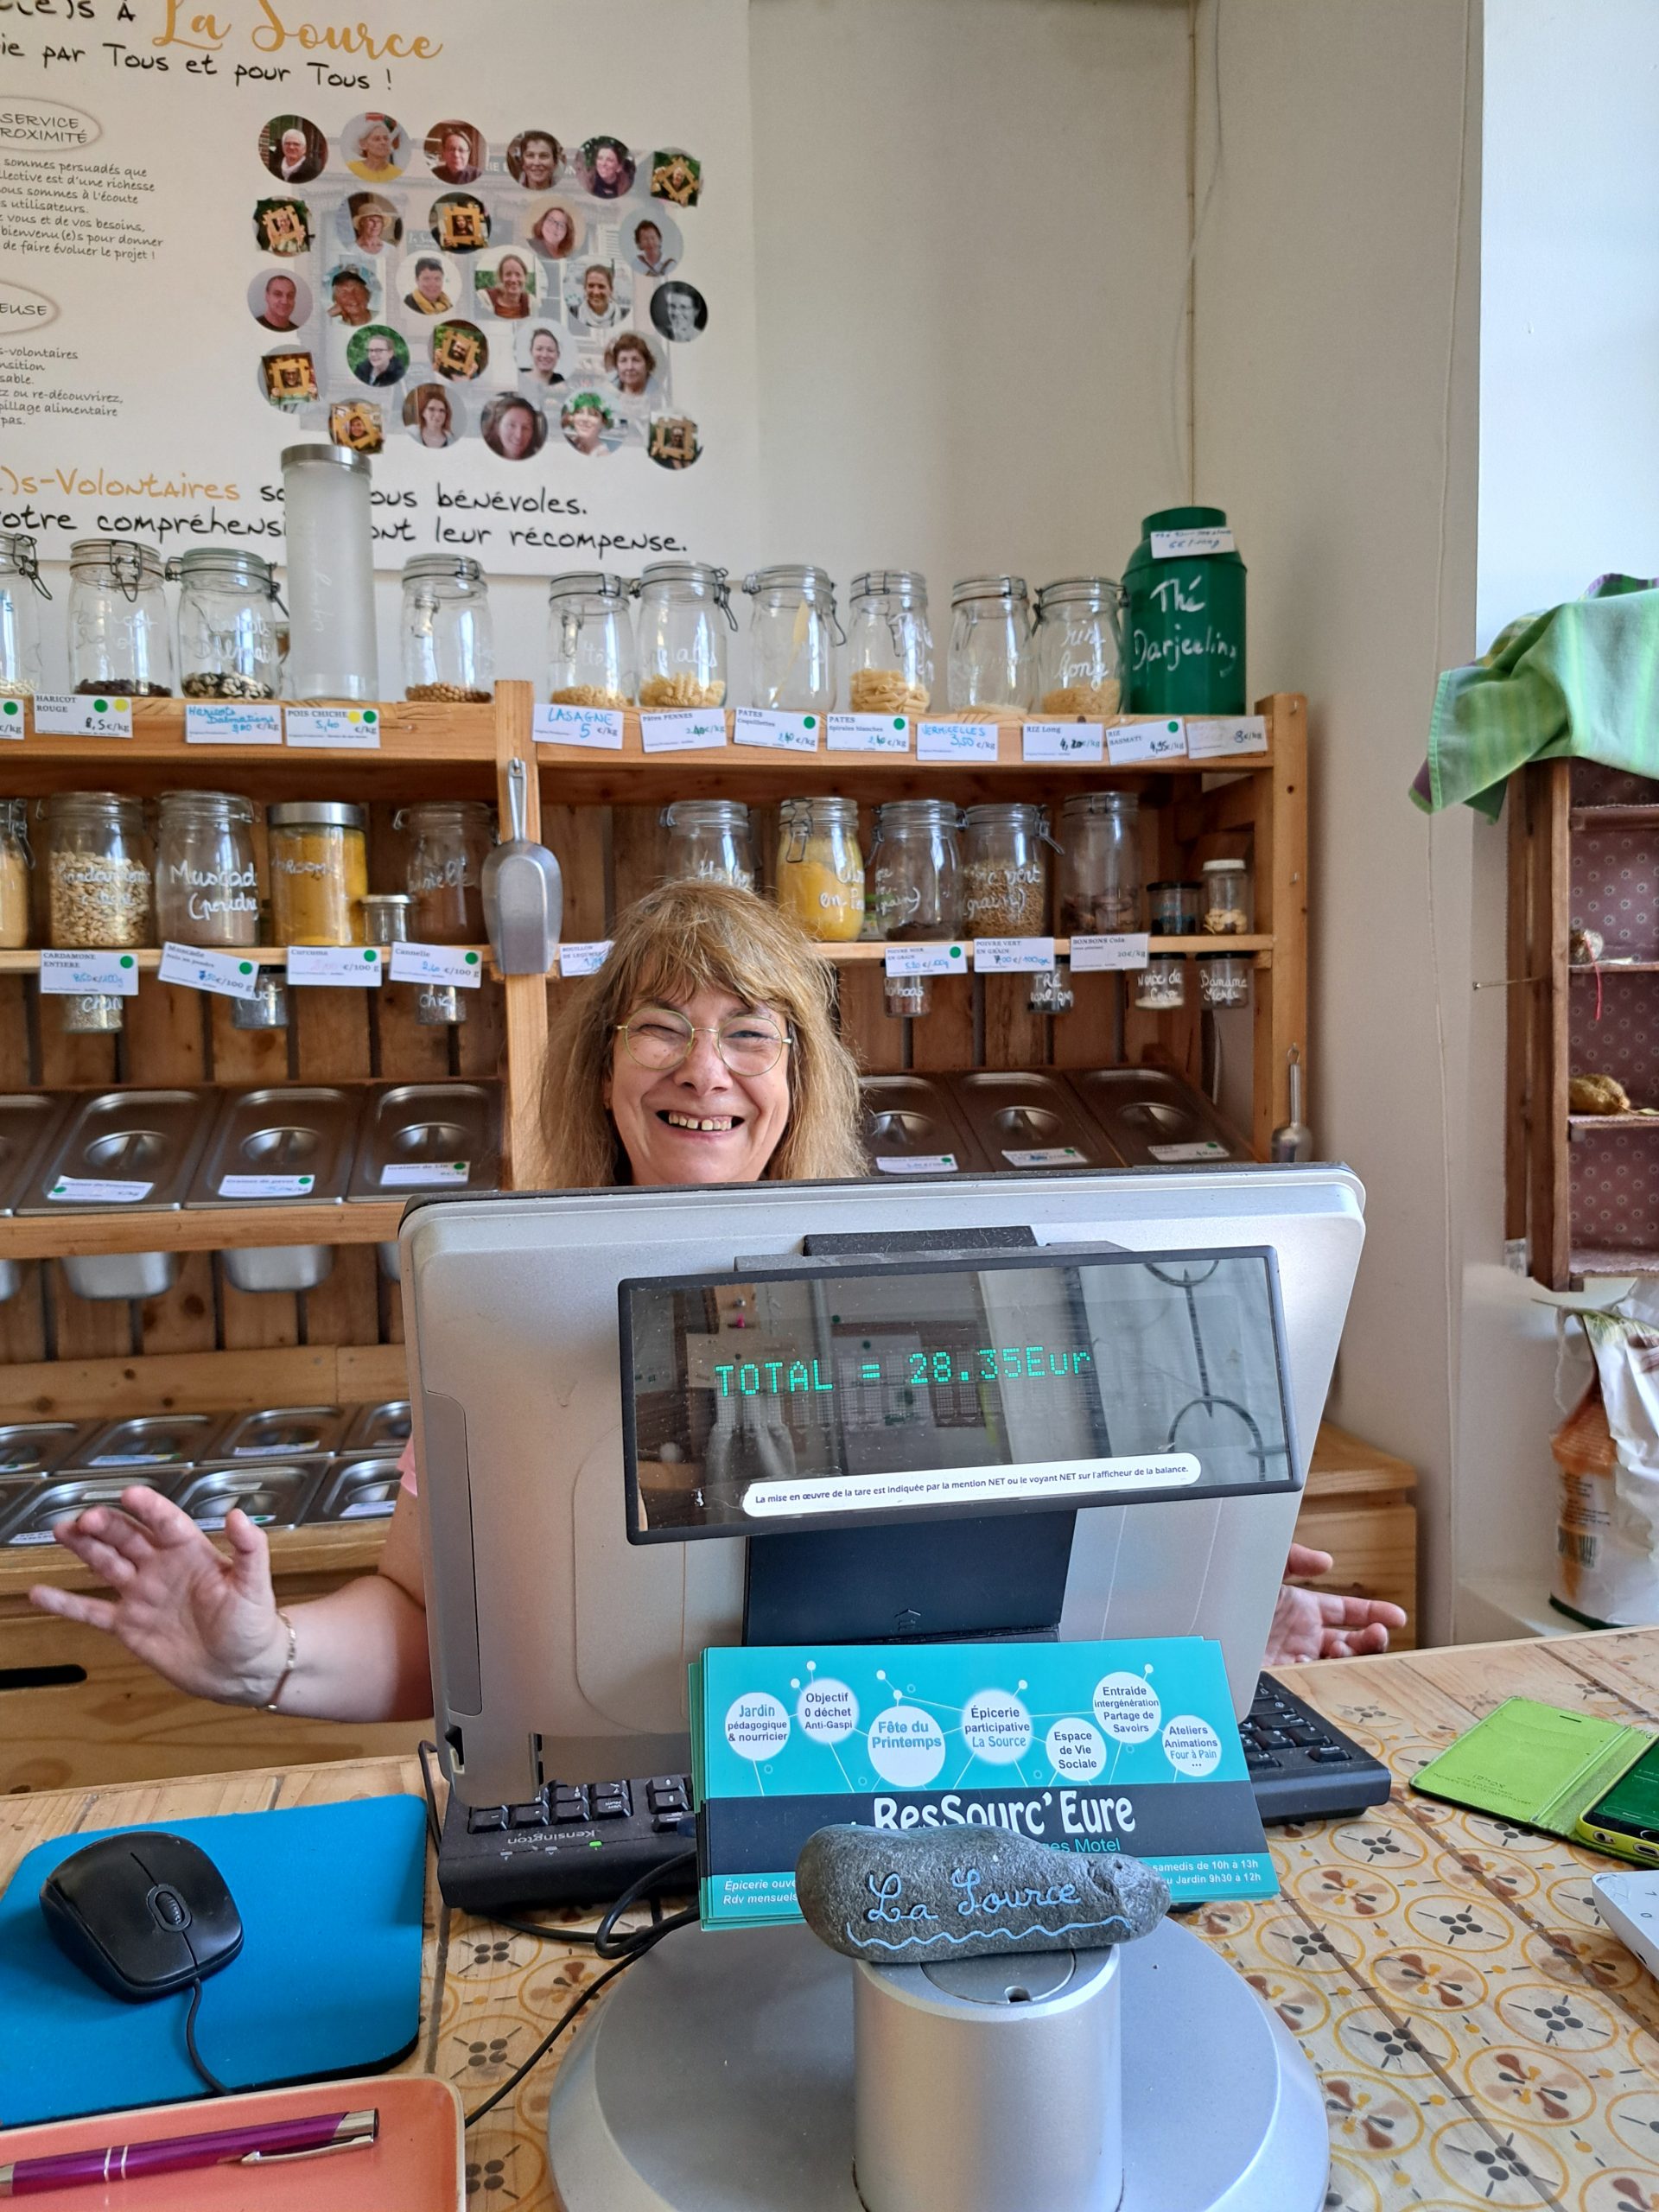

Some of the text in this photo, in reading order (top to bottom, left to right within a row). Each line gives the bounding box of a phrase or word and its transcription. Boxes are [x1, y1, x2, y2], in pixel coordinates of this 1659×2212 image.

[152, 0, 443, 60] La Source
[103, 43, 169, 71] Tous
[186, 54, 218, 74] et
[234, 64, 290, 86] pour
[307, 62, 371, 90] Tous
[386, 68, 392, 90] !
[0, 113, 79, 129] SERVICE
[3, 158, 148, 180] sommes persuadés que
[46, 175, 156, 192] est d'une richesse
[27, 189, 139, 204] sommes à l'écoute
[11, 199, 89, 213] utilisateurs.
[7, 215, 36, 225] vous
[41, 216, 51, 225] et
[54, 216, 69, 226] de
[73, 219, 92, 228] vos
[2, 226, 163, 247] bienvenu(e)s pour donner
[3, 240, 17, 251] de
[21, 241, 51, 254] faire
[54, 242, 98, 257] évoluer
[101, 247, 111, 257] le
[115, 249, 148, 263] projet
[44, 404, 118, 416] alimentaire
[437, 482, 588, 515] bénévoles.
[435, 517, 688, 560] leur récompense.
[1149, 575, 1206, 613] Thé
[1131, 623, 1237, 678] Darjeeling
[35, 695, 76, 704] HARICOT
[35, 705, 68, 714] ROUGE
[288, 710, 309, 719] POIS
[738, 709, 763, 718] PATES
[548, 707, 613, 726] LASAGNE
[715, 1345, 1090, 1396] TOTAL = 28.35Eur
[768, 1493, 787, 1503] mise
[803, 1491, 830, 1500] œuvre
[832, 1489, 843, 1497] de
[845, 1489, 853, 1497] la
[855, 1488, 872, 1497] tare
[874, 1486, 886, 1495] est
[887, 1484, 925, 1493] indiquée
[926, 1483, 941, 1492] par
[942, 1481, 950, 1490] la
[951, 1478, 987, 1489] mention
[988, 1477, 1005, 1486] NET
[1007, 1477, 1019, 1485] ou
[1020, 1475, 1027, 1484] le
[1029, 1474, 1058, 1484] voyant
[1059, 1472, 1077, 1482] NET
[1092, 1469, 1133, 1480] l'afficheur
[1147, 1466, 1154, 1475] la
[1155, 1465, 1189, 1475] balance.
[1103, 1686, 1147, 1697] Entraide
[806, 1693, 849, 1704] Objectif
[1094, 1698, 1160, 1710] intergénération
[739, 1704, 775, 1718] Jardin
[804, 1707, 851, 1718] 0 déchet
[970, 1705, 1020, 1719] Épicerie
[1103, 1710, 1154, 1724] Partage de
[728, 1720, 787, 1732] pédagogique
[804, 1720, 853, 1732] Anti-Gaspi
[878, 1720, 929, 1733] Fête du
[964, 1722, 1030, 1734] participative
[1113, 1723, 1149, 1733] Savoirs
[1169, 1725, 1208, 1736] Ateliers
[739, 1732, 787, 1742] nourricier
[872, 1736, 942, 1751] Printemps
[972, 1735, 1027, 1748] La Source
[1054, 1731, 1092, 1743] Espace
[1059, 1745, 1091, 1755] de Vie
[1164, 1738, 1218, 1750] Animations
[1170, 1749, 1217, 1760] Four à Pain
[1058, 1758, 1096, 1770] Sociale
[507, 1828, 597, 1846] Kensington
[1075, 1836, 1121, 1853] Motel
[1152, 1859, 1259, 1872] samedis de 10h à 13h
[724, 1878, 769, 1891] Épicerie
[1176, 1872, 1262, 1885] Jardin 9h30 à 12h
[723, 1894, 744, 1905] Rdv
[868, 1867, 1081, 1923] La Source
